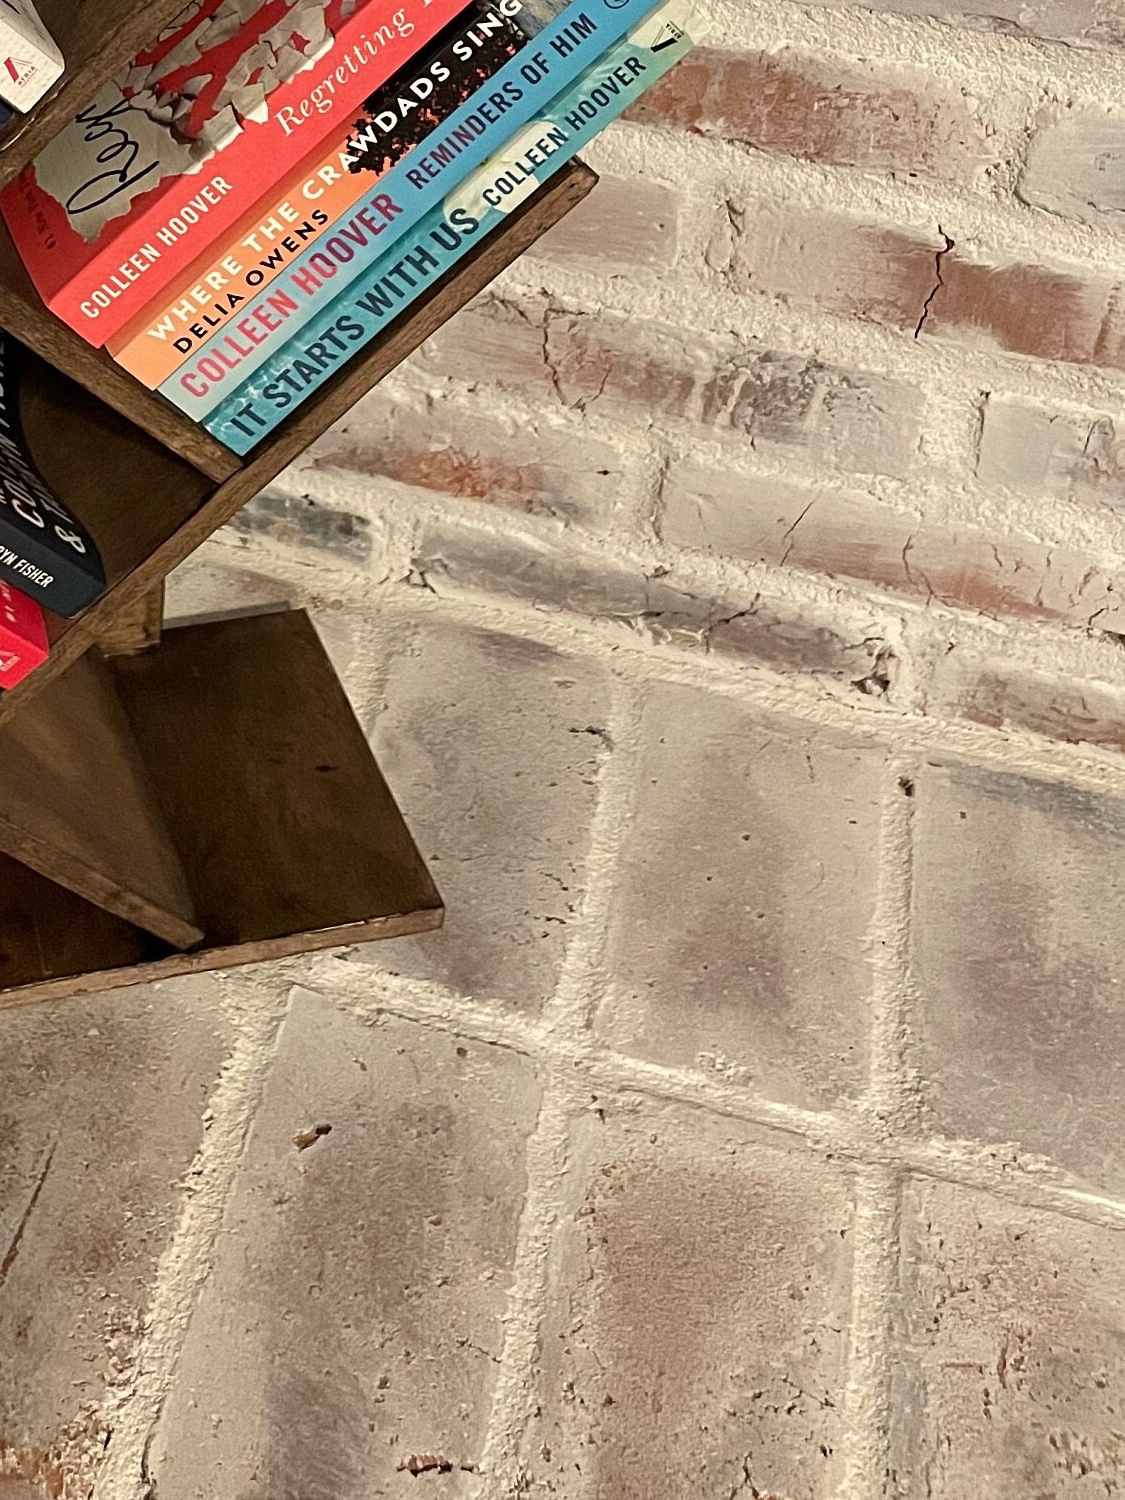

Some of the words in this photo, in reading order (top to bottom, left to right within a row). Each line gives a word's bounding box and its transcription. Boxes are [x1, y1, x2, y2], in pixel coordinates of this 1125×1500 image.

[17, 64, 39, 89] ATRIA
[275, 12, 415, 136] Regretting
[482, 125, 569, 211] COLLEEN
[562, 55, 647, 135] HOOVER
[79, 235, 165, 320] COLLEEN
[155, 176, 234, 247] HOOVER
[149, 258, 244, 340] WHERE
[247, 203, 300, 254] THE
[302, 61, 452, 202] CRAWDADS
[180, 293, 299, 398] COLLEEN
[290, 192, 405, 292] HOOVER
[405, 80, 525, 190] REMINDERS
[519, 51, 551, 85] OF
[549, 12, 598, 58] HIM
[173, 288, 245, 356] DELIA
[244, 207, 330, 288] OWENS
[230, 391, 278, 439] IT
[262, 312, 367, 412] STARTS
[356, 235, 441, 328] WITH
[426, 206, 480, 255] US
[13, 559, 54, 588] FISHER
[54, 525, 87, 554] &
